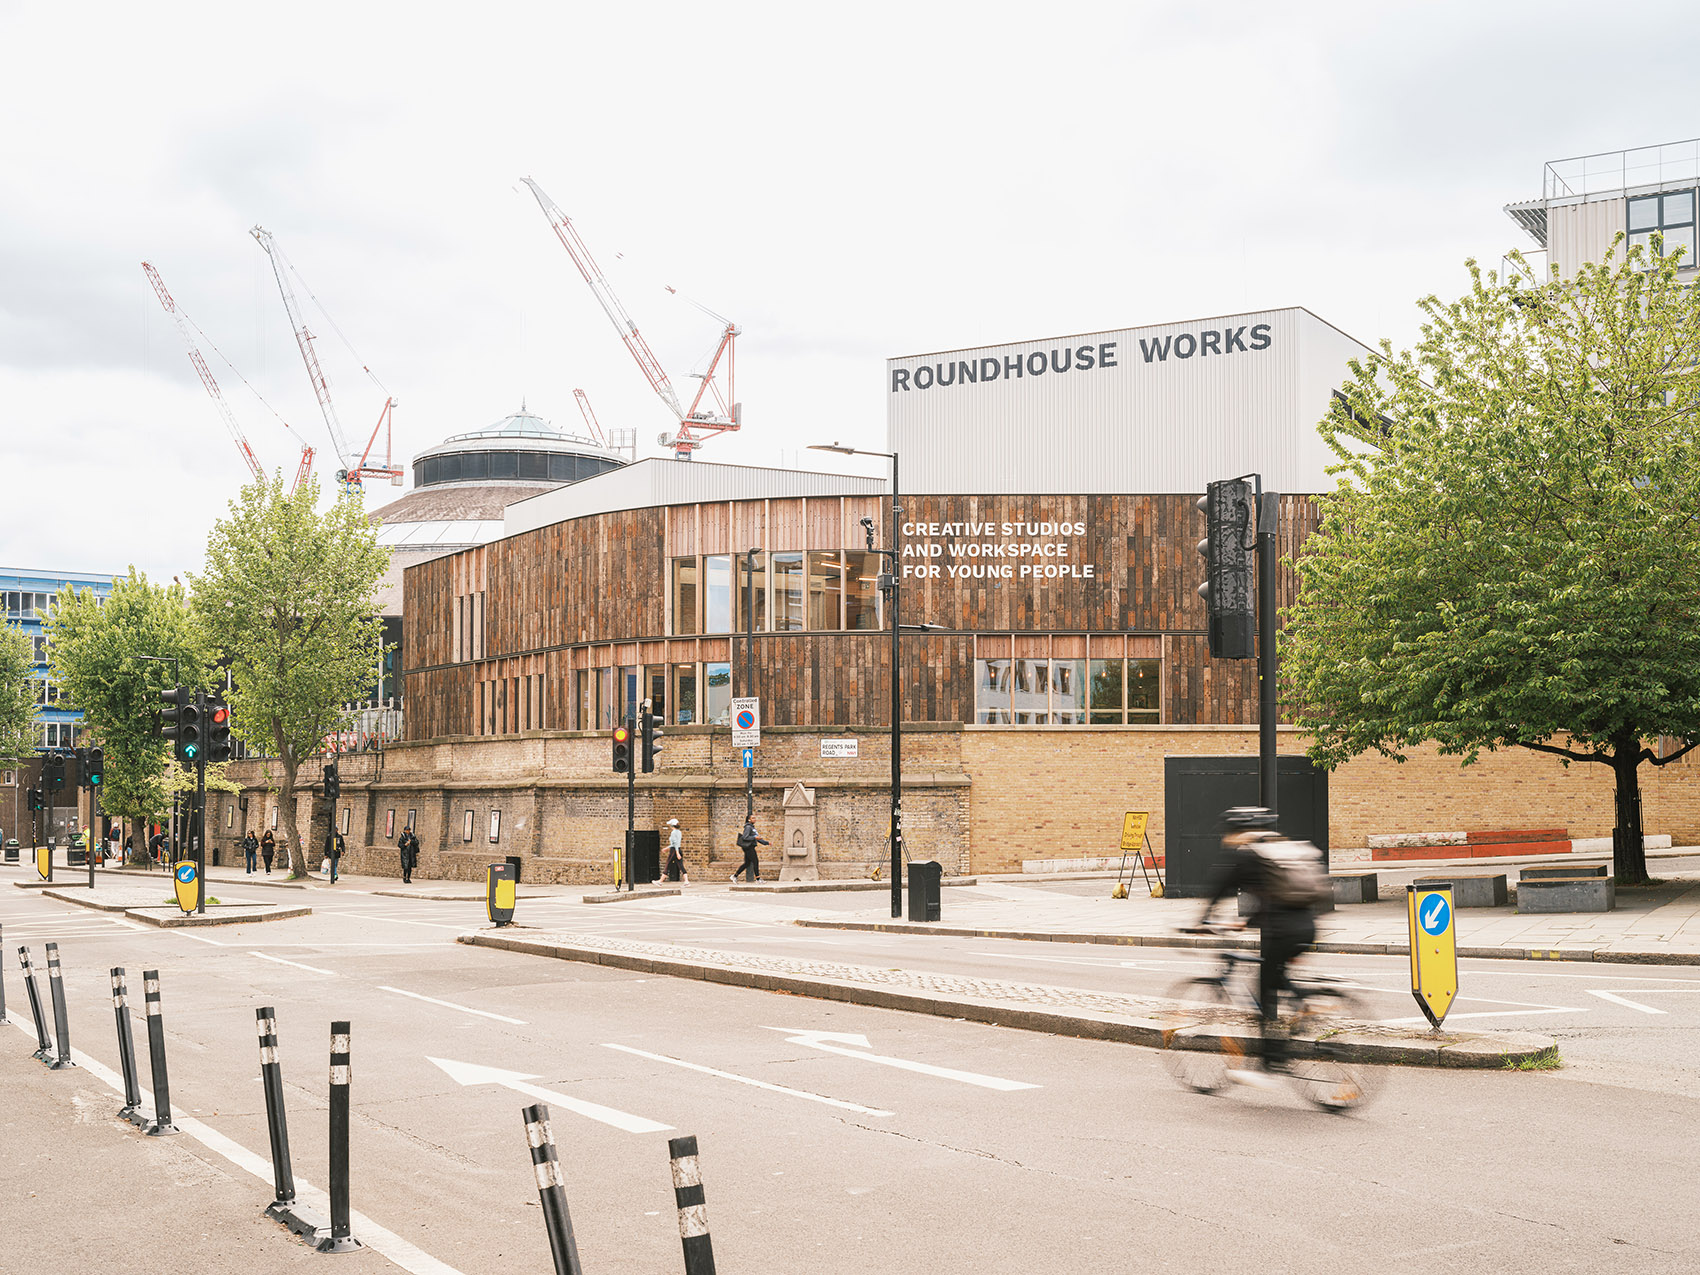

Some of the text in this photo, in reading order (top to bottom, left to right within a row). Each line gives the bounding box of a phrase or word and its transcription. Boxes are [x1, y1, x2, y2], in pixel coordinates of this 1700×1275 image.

[892, 323, 1272, 393] ROUNDHOUSE WORKS
[901, 522, 1086, 537] CREATIVE STUDIOS
[901, 543, 1068, 558] AND WORKSPACE
[902, 564, 1094, 579] FOR YOUNG PEOPLE
